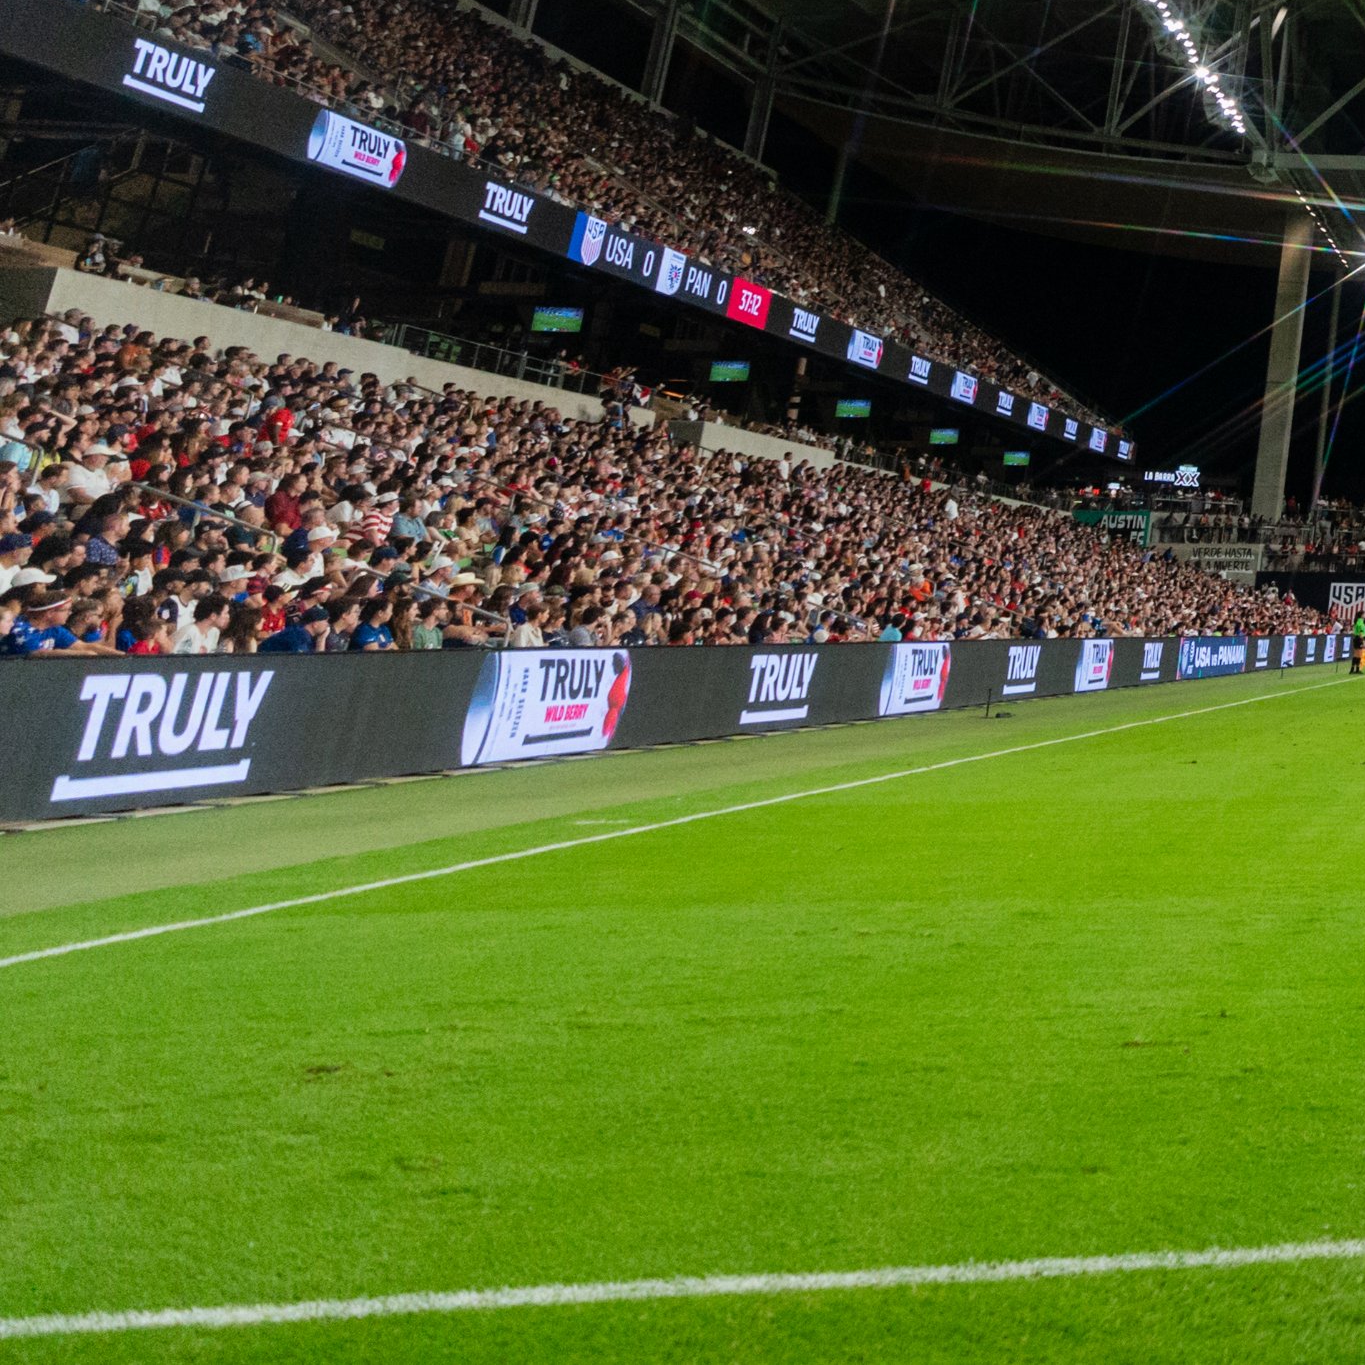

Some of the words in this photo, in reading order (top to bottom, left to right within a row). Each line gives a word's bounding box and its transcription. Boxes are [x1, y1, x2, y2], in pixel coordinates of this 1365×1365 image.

[133, 38, 215, 97] TRULY
[351, 125, 390, 159] TRULY
[486, 182, 534, 222] TRULY
[588, 220, 605, 240] USA
[605, 234, 634, 270] USA
[643, 250, 655, 277] 0
[685, 267, 712, 299] PAN
[716, 280, 727, 304] 0
[738, 289, 762, 316] 37:12
[792, 307, 820, 335] TRULY
[911, 355, 931, 377] TRULY
[1100, 515, 1146, 529] AUSTIN
[1129, 531, 1145, 545] FC
[1193, 547, 1222, 558] VERDE
[1225, 547, 1252, 558] HASTA
[1213, 560, 1250, 571] MUERTE
[1333, 585, 1365, 605] USA
[912, 649, 940, 677] TRULY
[1007, 645, 1041, 680] TRULY
[1143, 642, 1164, 668] TRULY
[1195, 646, 1211, 668] USA
[1217, 645, 1245, 665] PANAMA
[540, 658, 606, 702] TRULY
[748, 653, 818, 703] TRULY
[78, 670, 274, 762] TRULY
[544, 706, 562, 723] WILD
[564, 704, 589, 721] BERRY
